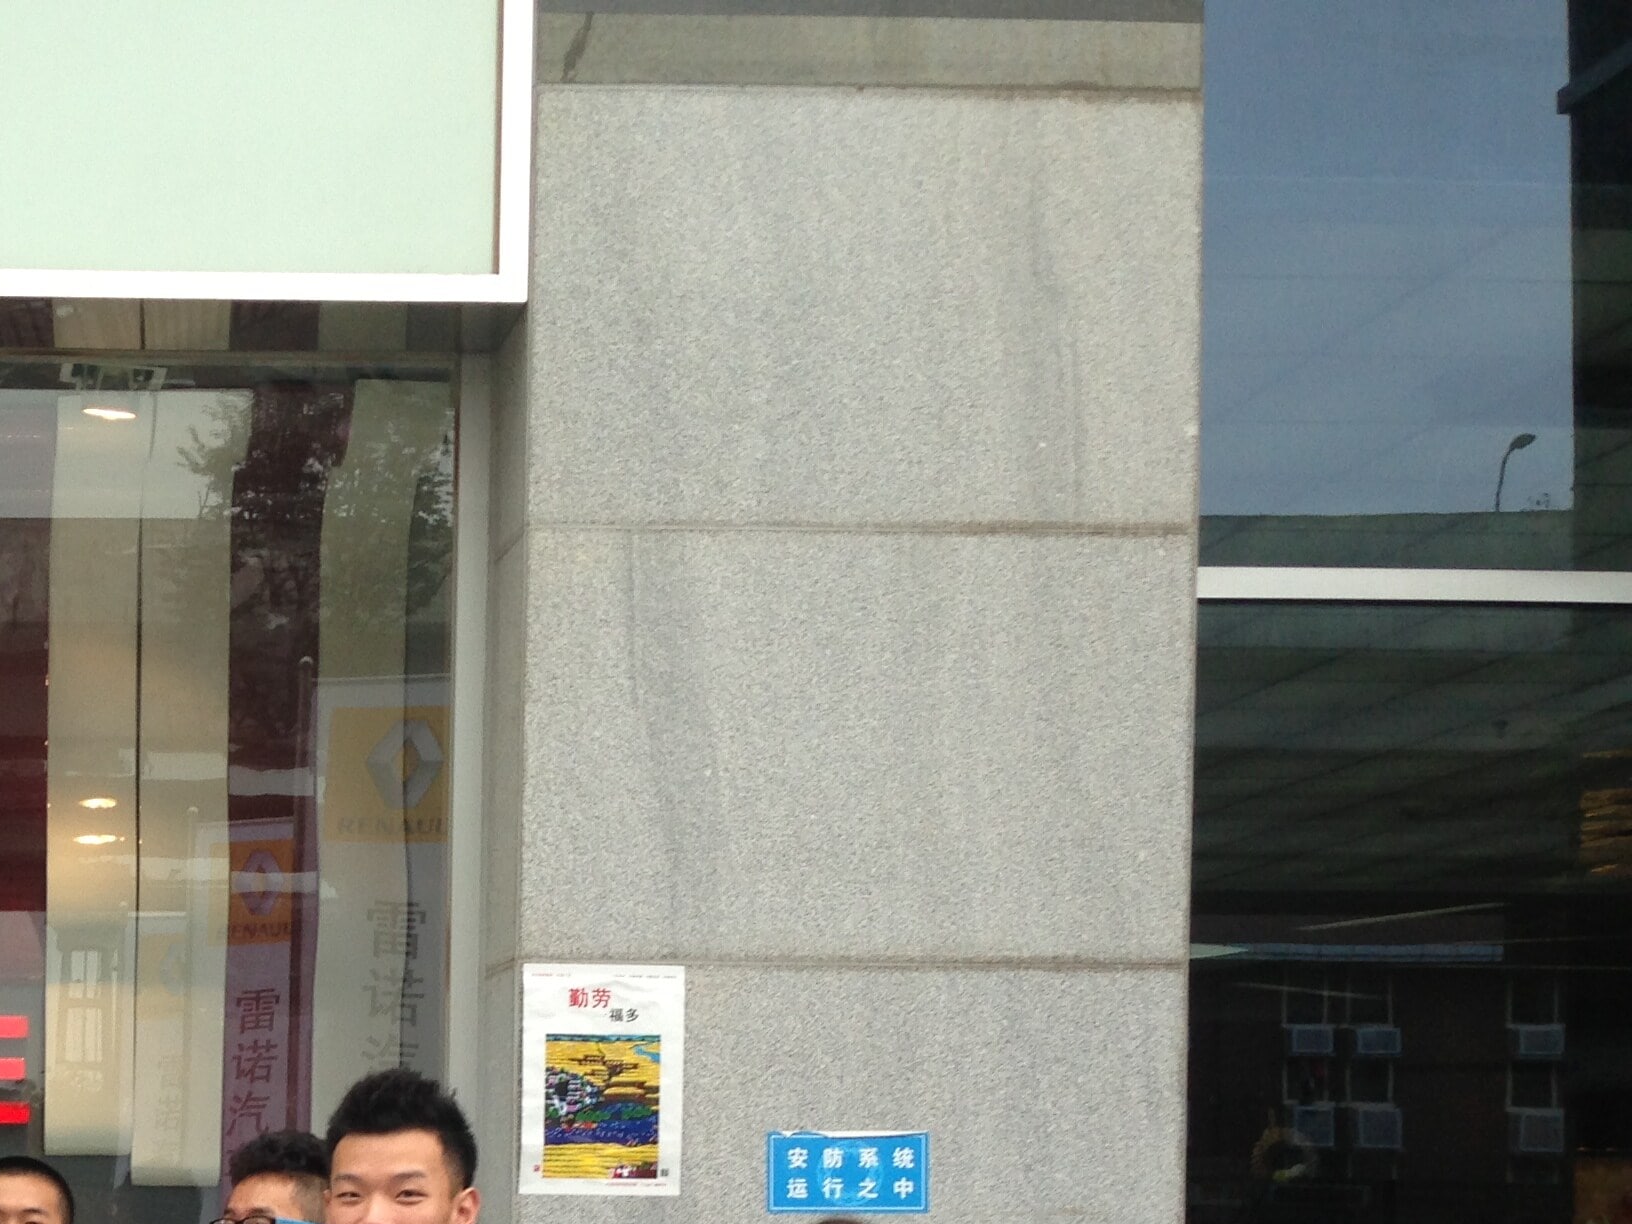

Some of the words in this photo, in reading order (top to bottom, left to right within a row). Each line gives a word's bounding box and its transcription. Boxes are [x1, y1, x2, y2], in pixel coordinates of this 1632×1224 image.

[568, 988, 611, 1008] 勤劳
[786, 1147, 915, 1169] 安防系统
[786, 1177, 915, 1199] 运行之中
